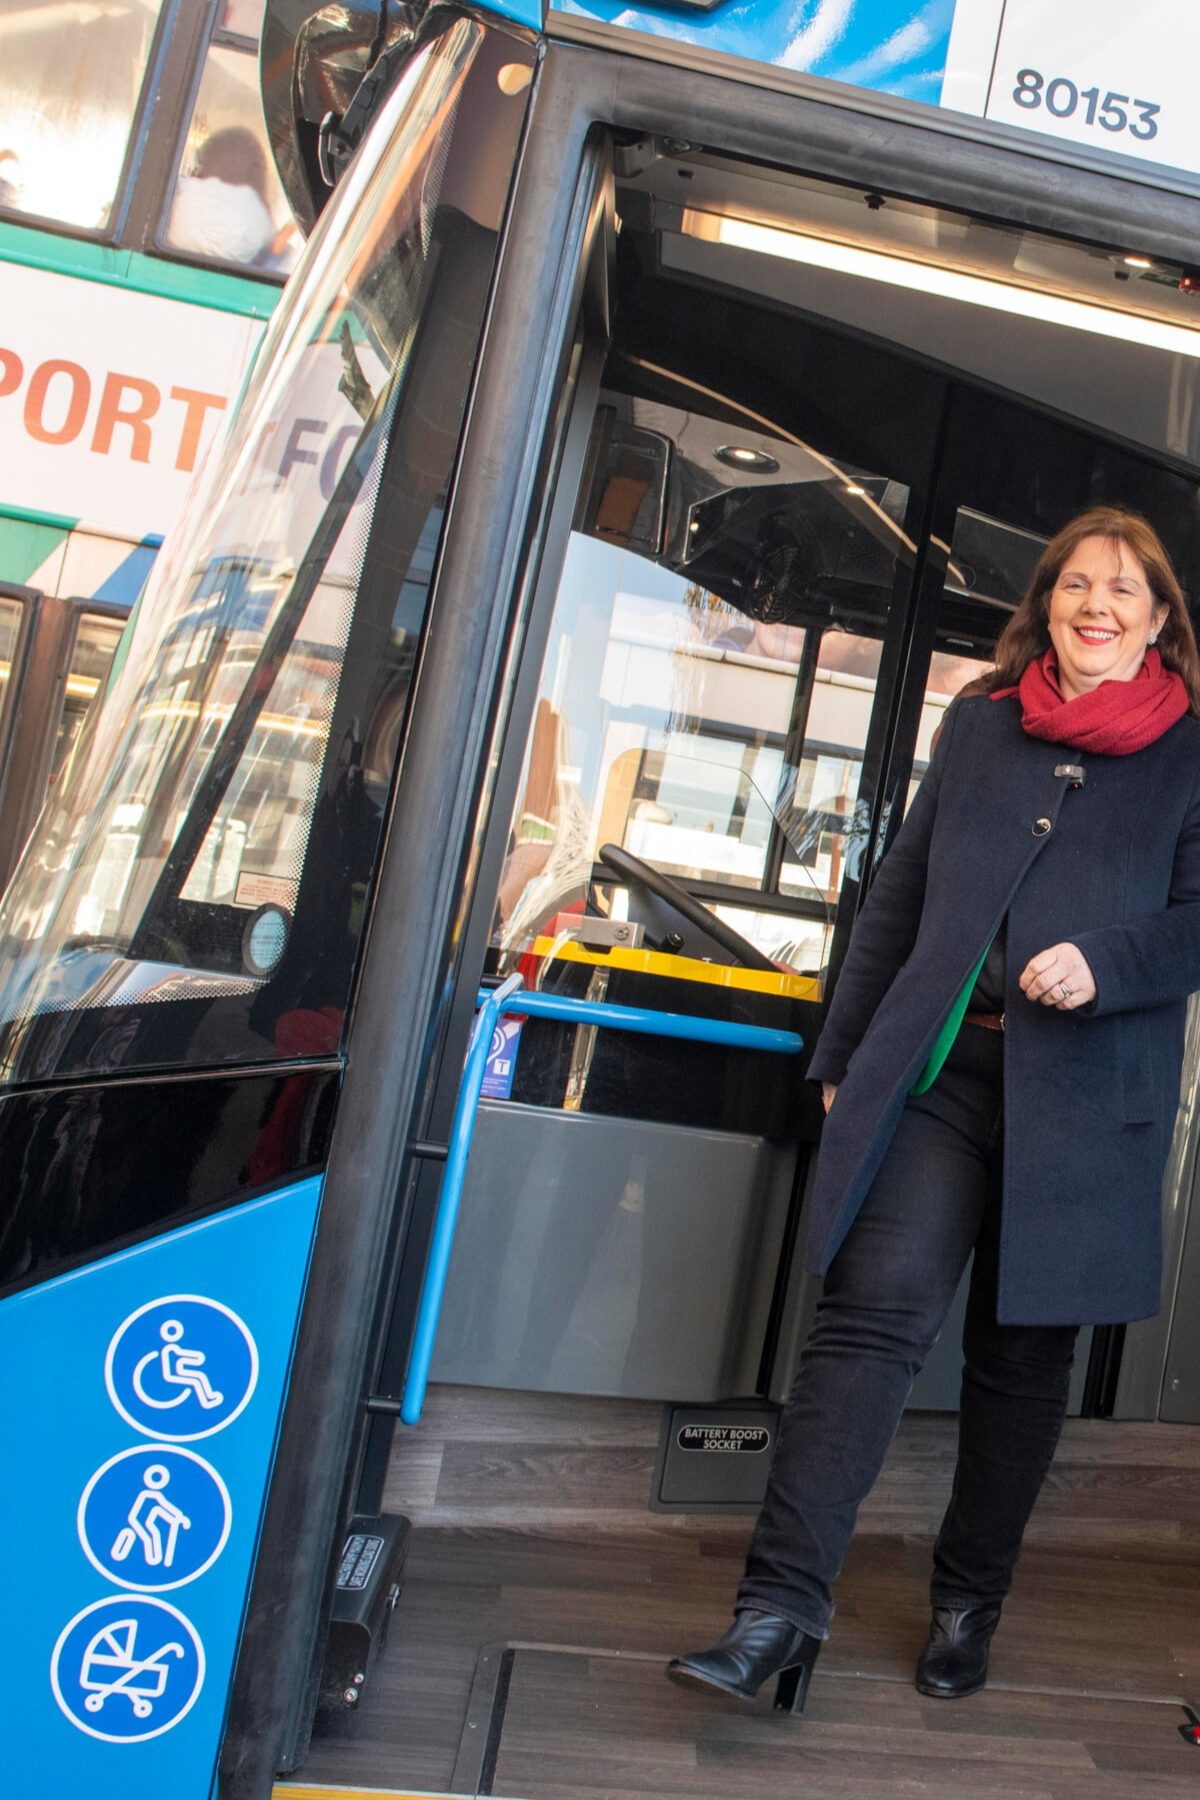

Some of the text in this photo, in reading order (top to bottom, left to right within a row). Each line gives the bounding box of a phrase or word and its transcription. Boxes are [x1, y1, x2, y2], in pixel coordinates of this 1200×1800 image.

[1012, 69, 1161, 140] 80153
[684, 1428, 764, 1440] BATTERY BOOST
[703, 1439, 743, 1450] SOCKET
